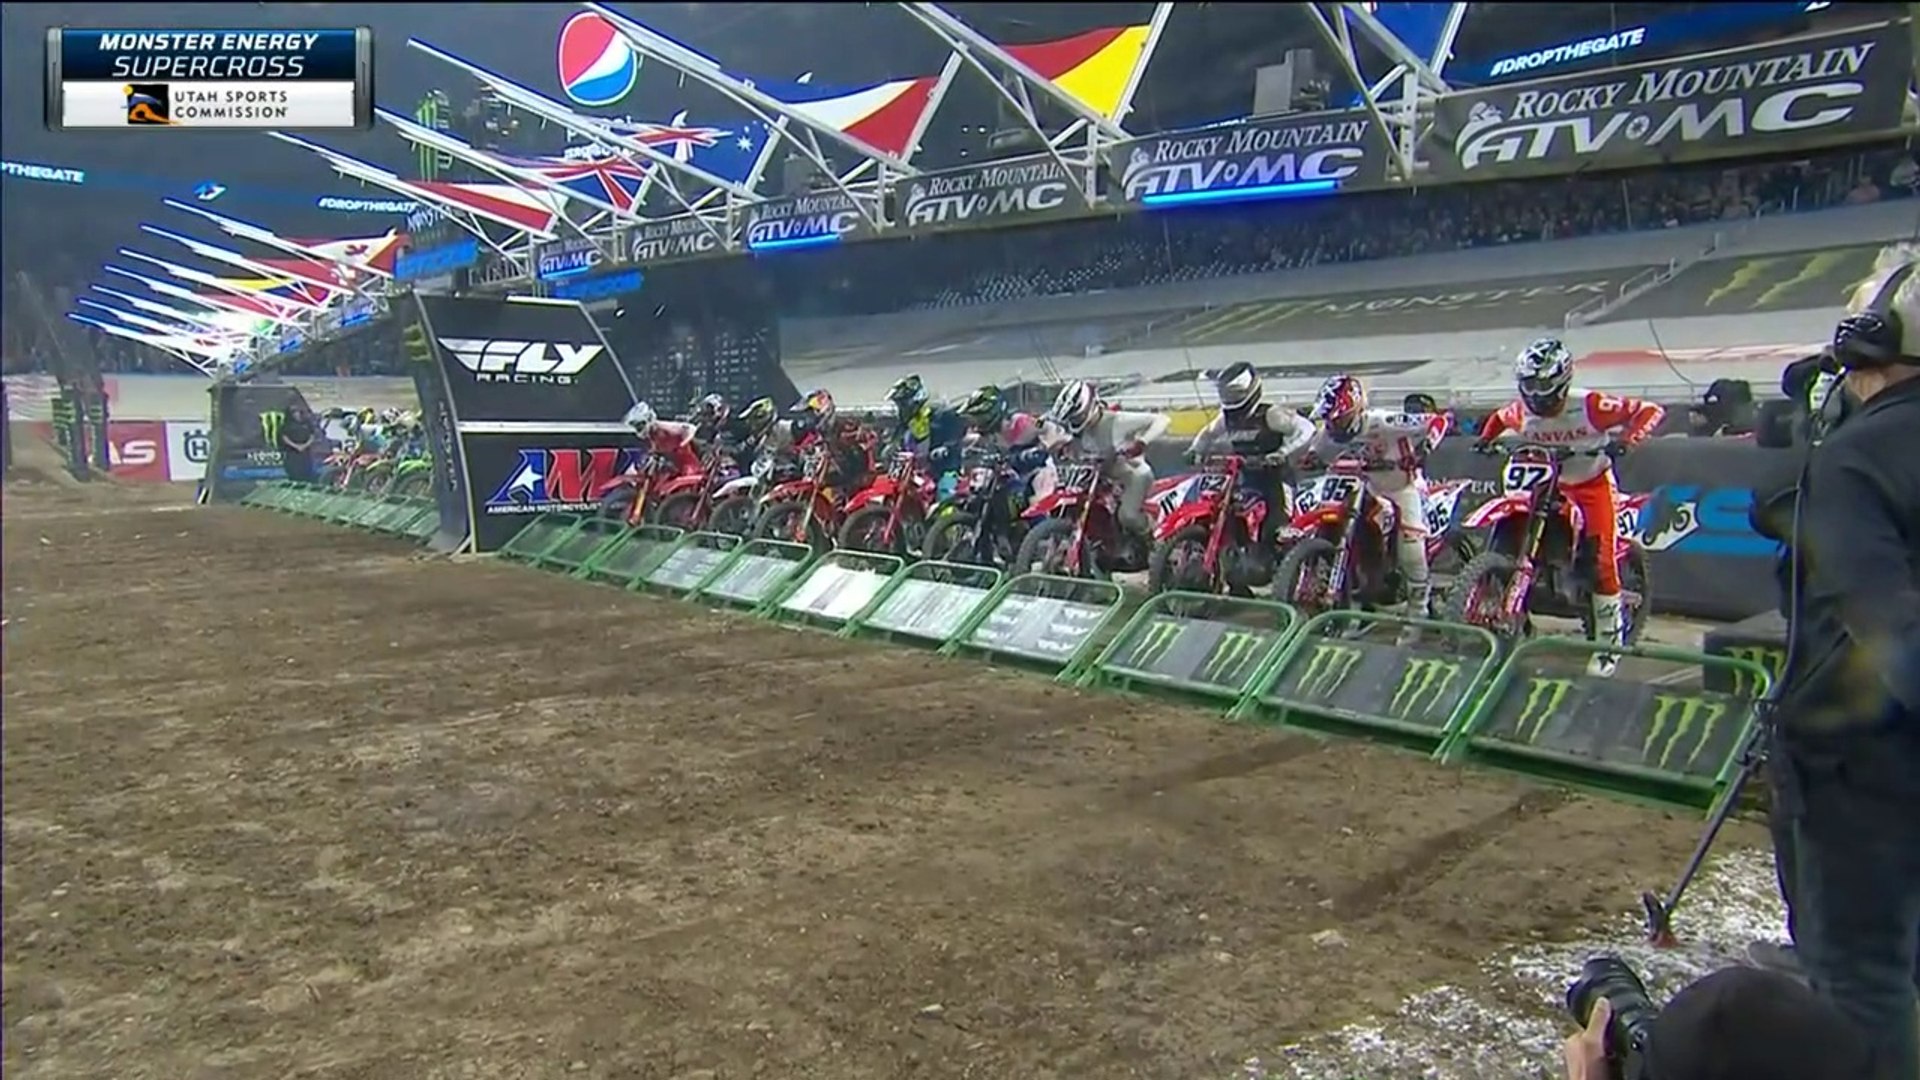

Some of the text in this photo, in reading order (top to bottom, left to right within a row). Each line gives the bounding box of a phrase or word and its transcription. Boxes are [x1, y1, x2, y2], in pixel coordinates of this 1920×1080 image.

[1490, 27, 1645, 77] #DROPTHEGATE
[1508, 42, 1876, 121] ROCKY MOUNTAIN
[1153, 136, 1224, 163] ROCKY
[1227, 119, 1369, 154] MOUNTAIN
[928, 175, 977, 197] ROCKY
[437, 337, 604, 374] FLY
[476, 373, 572, 384] RACING
[1506, 465, 1547, 492] 97
[487, 504, 536, 514] AMERICAN
